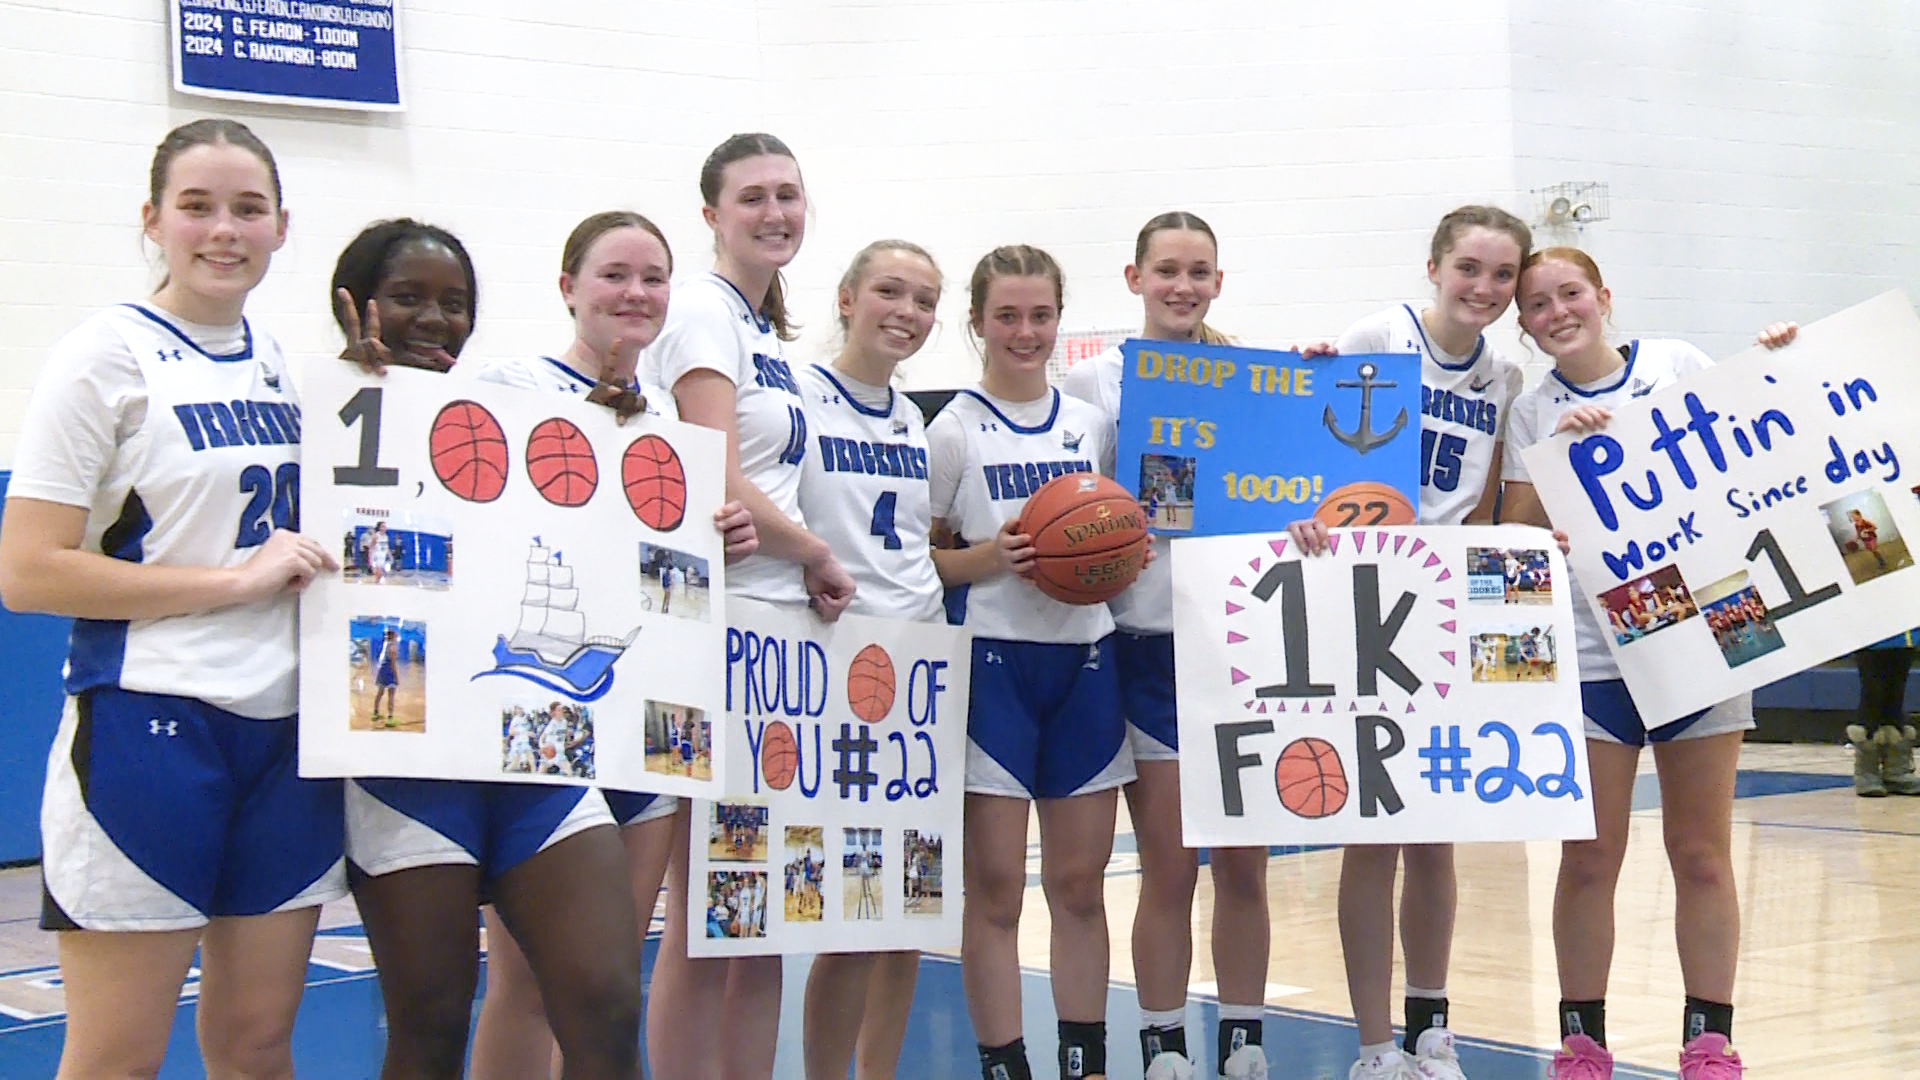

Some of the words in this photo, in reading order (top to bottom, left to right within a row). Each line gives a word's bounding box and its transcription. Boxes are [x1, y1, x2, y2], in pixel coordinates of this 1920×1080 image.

[183, 11, 223, 33] 2024
[184, 35, 223, 56] 2024
[1136, 349, 1236, 388] DROP
[1248, 363, 1314, 396] THE
[1822, 376, 1878, 417] in
[1148, 416, 1216, 448] IT'S
[1420, 429, 1467, 492] 15
[1824, 434, 1901, 483] day
[235, 462, 301, 550] 20
[1222, 471, 1323, 503] 1000!
[870, 491, 902, 549] 4
[1063, 511, 1142, 548] SPALDING
[1336, 501, 1389, 528] 22
[1745, 527, 1842, 622] 1
[726, 627, 828, 717] PROUD
[908, 659, 948, 726] OF
[832, 723, 939, 802] #22
[1418, 721, 1584, 804] #22
